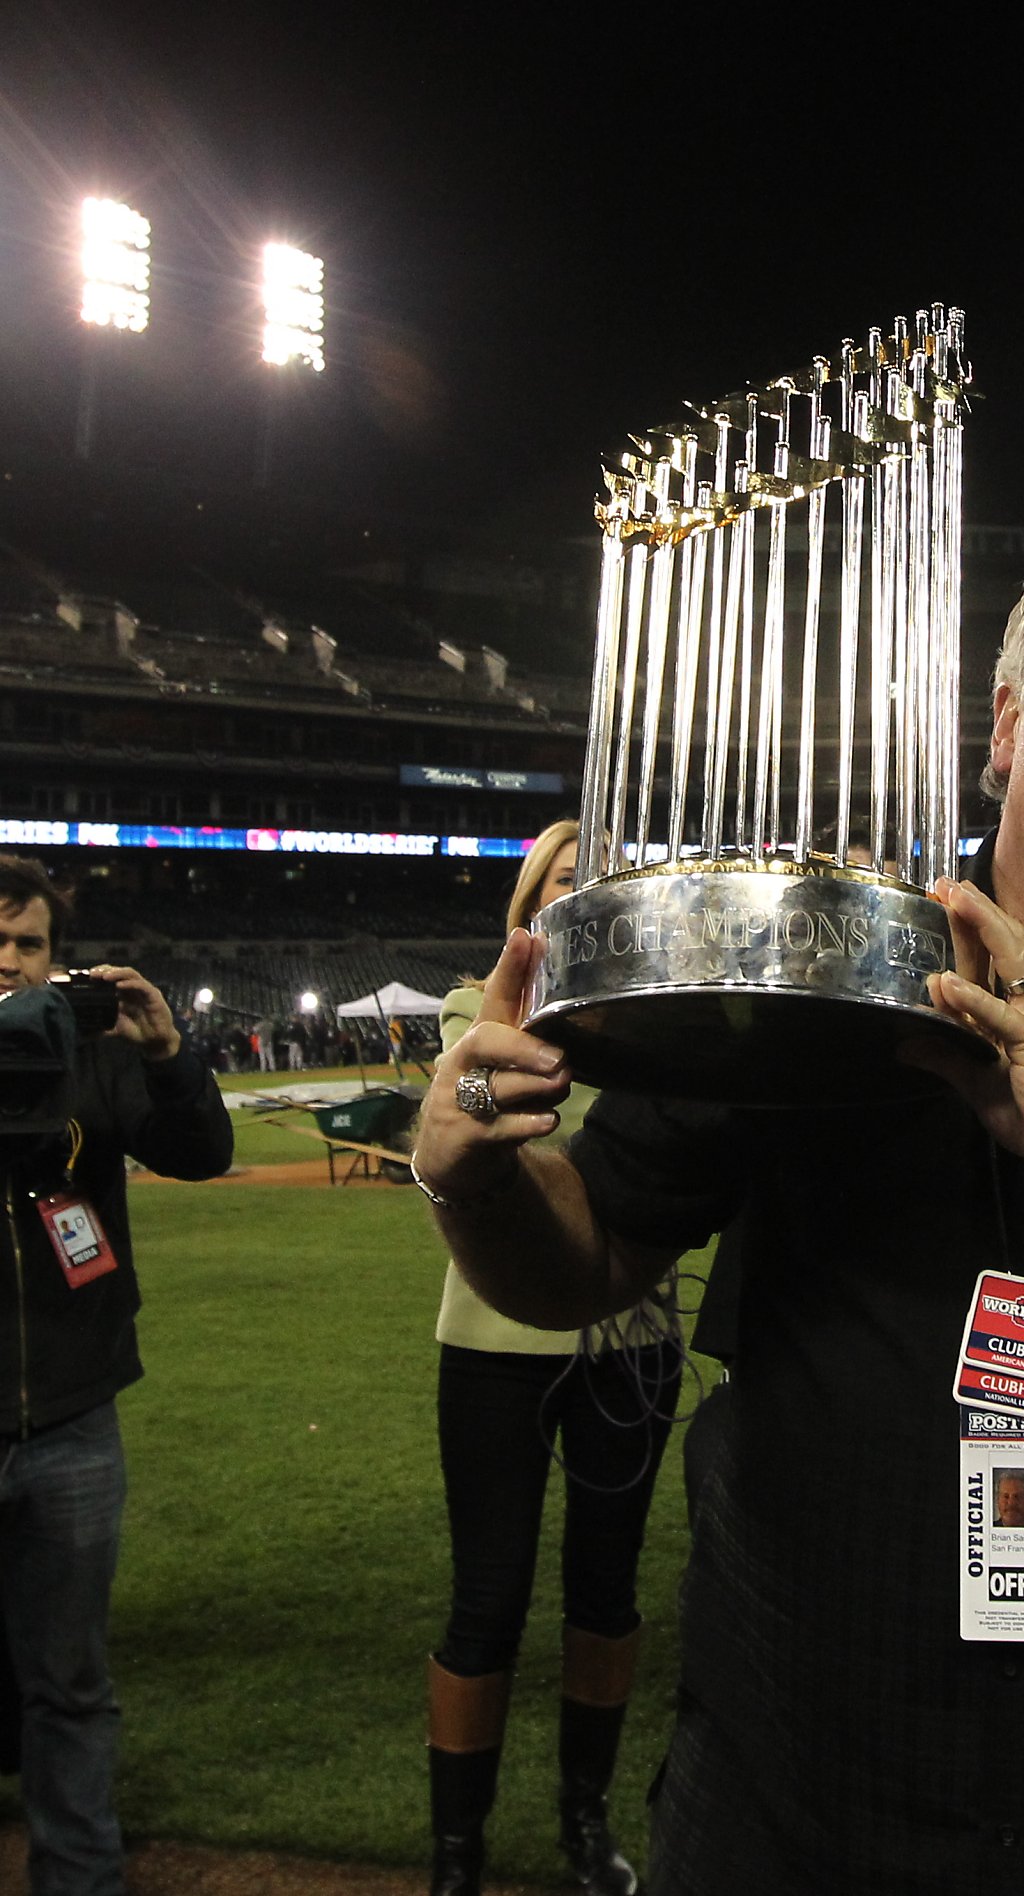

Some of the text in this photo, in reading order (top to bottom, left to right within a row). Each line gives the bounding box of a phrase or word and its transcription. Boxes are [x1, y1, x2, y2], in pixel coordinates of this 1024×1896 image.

[607, 906, 870, 960] CHAMPIONS
[984, 1392, 1017, 1406] NATIONAL
[968, 1472, 984, 1578] OFFICIAL
[991, 1533, 1011, 1542] Brian
[991, 1545, 1006, 1553] San
